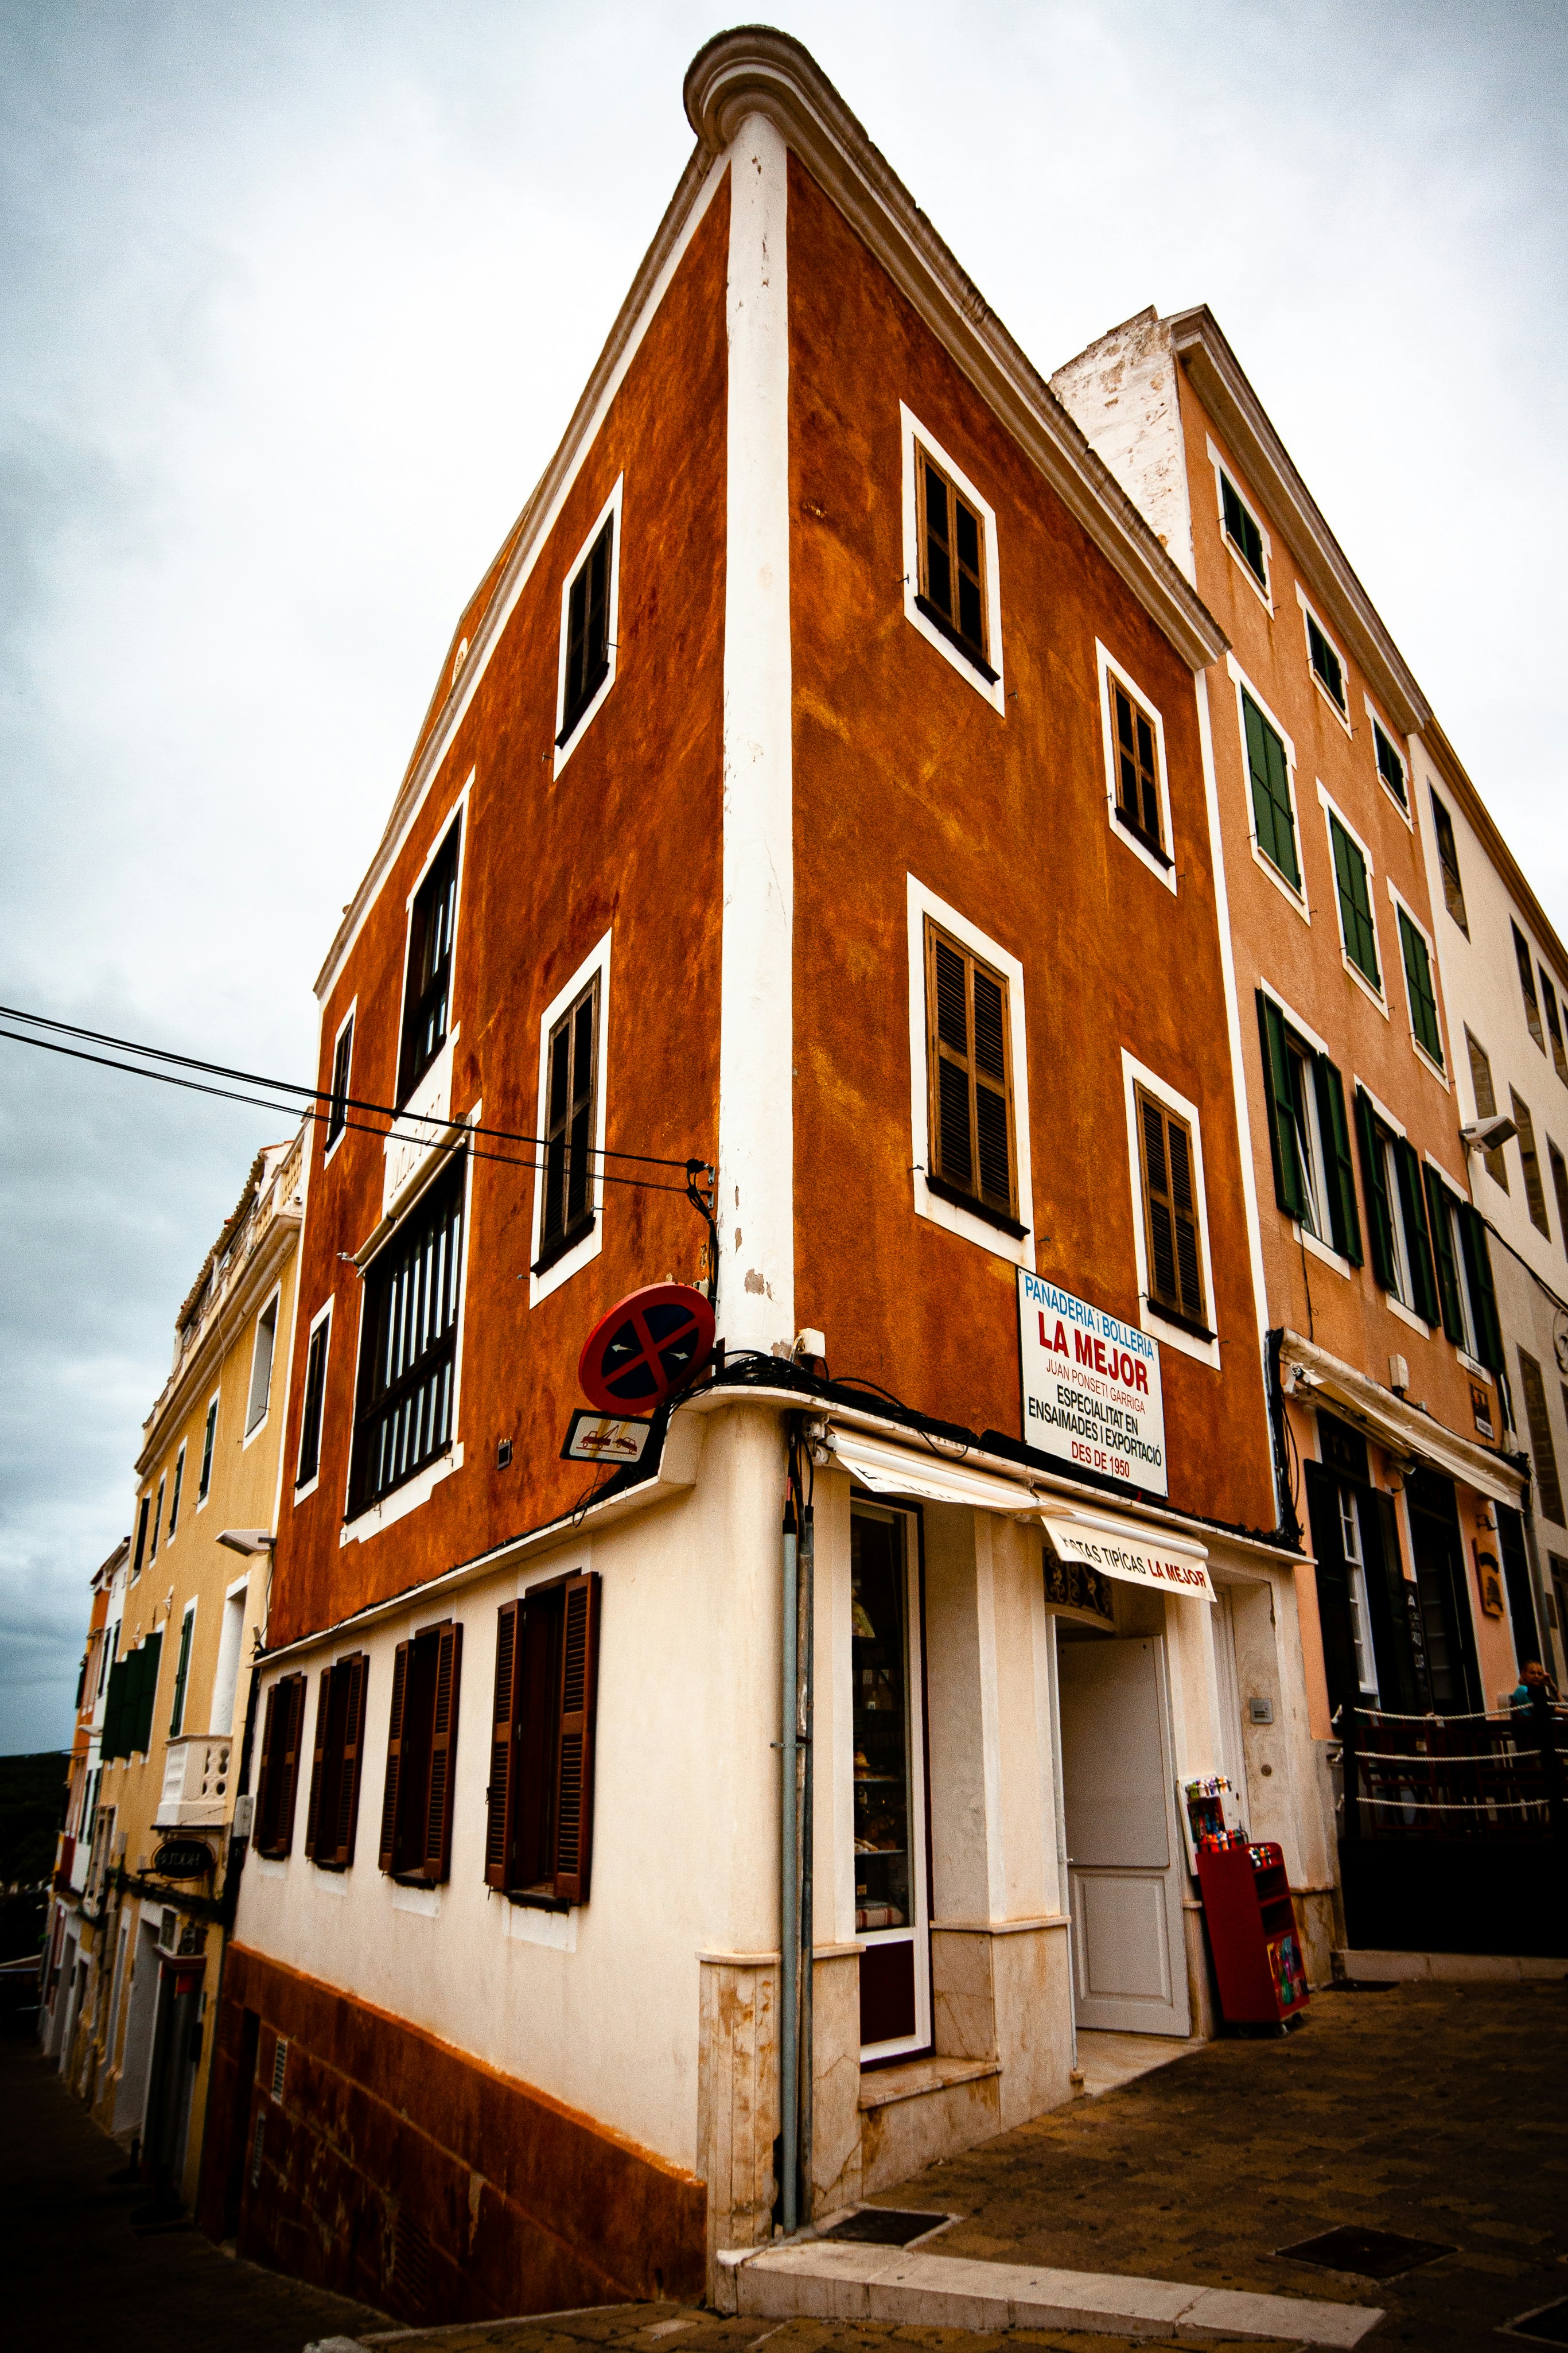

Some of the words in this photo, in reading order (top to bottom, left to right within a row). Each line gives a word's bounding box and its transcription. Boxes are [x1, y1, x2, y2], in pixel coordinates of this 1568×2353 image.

[1025, 1275, 1095, 1330] PANADERIA
[1103, 1315, 1154, 1361] BOLLERIA
[1038, 1311, 1069, 1358] LA
[1075, 1329, 1149, 1395] MEJOR
[1046, 1358, 1069, 1380] JUAN
[1072, 1369, 1108, 1397] PONSETI
[1111, 1387, 1145, 1414] GARRIGA
[1057, 1384, 1123, 1429] ESPECIALITAT
[1126, 1415, 1138, 1435] EN
[1029, 1396, 1097, 1442] ENSAIMADES
[1106, 1428, 1161, 1466] EXPORTACIÓ
[1072, 1441, 1091, 1463] DES
[1095, 1449, 1107, 1470] DE
[1110, 1455, 1130, 1478] 1950
[1101, 1547, 1146, 1574] TIPÍCAS
[1147, 1559, 1166, 1579] LA
[1165, 1563, 1206, 1588] MEJOR
